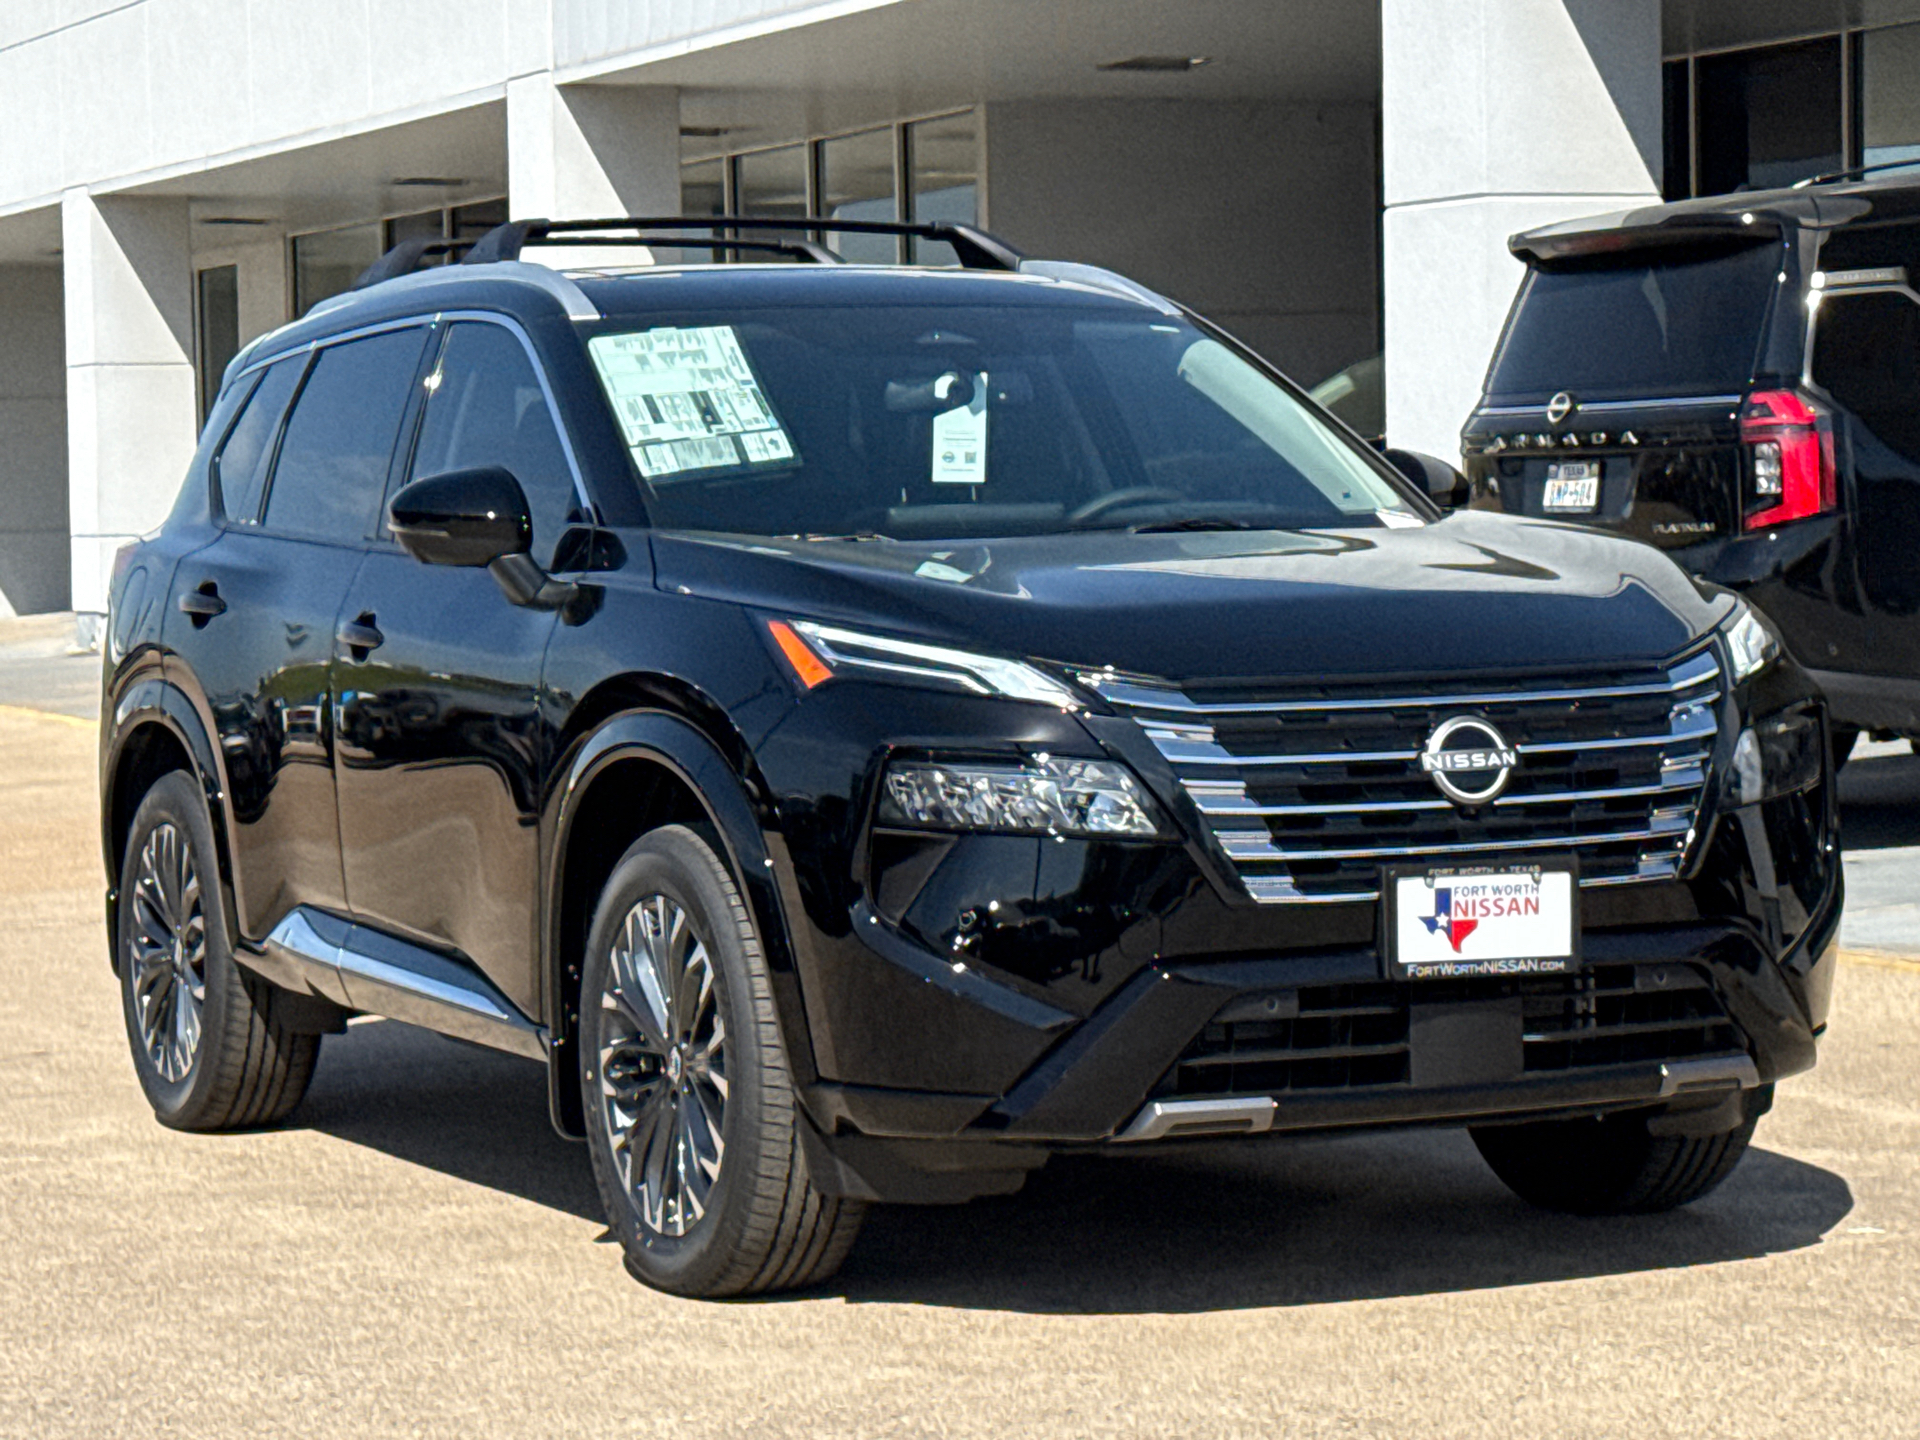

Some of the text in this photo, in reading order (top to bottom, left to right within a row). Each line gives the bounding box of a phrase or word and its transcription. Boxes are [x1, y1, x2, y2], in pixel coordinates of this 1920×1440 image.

[1493, 430, 1640, 450] ARMADA
[1563, 465, 1586, 476] TEXAS
[1422, 751, 1516, 770] NISSAN
[1428, 864, 1541, 876] FORT WORTH TEXAS
[1453, 883, 1540, 898] FORT WORTH
[1453, 896, 1540, 918] NISSAN
